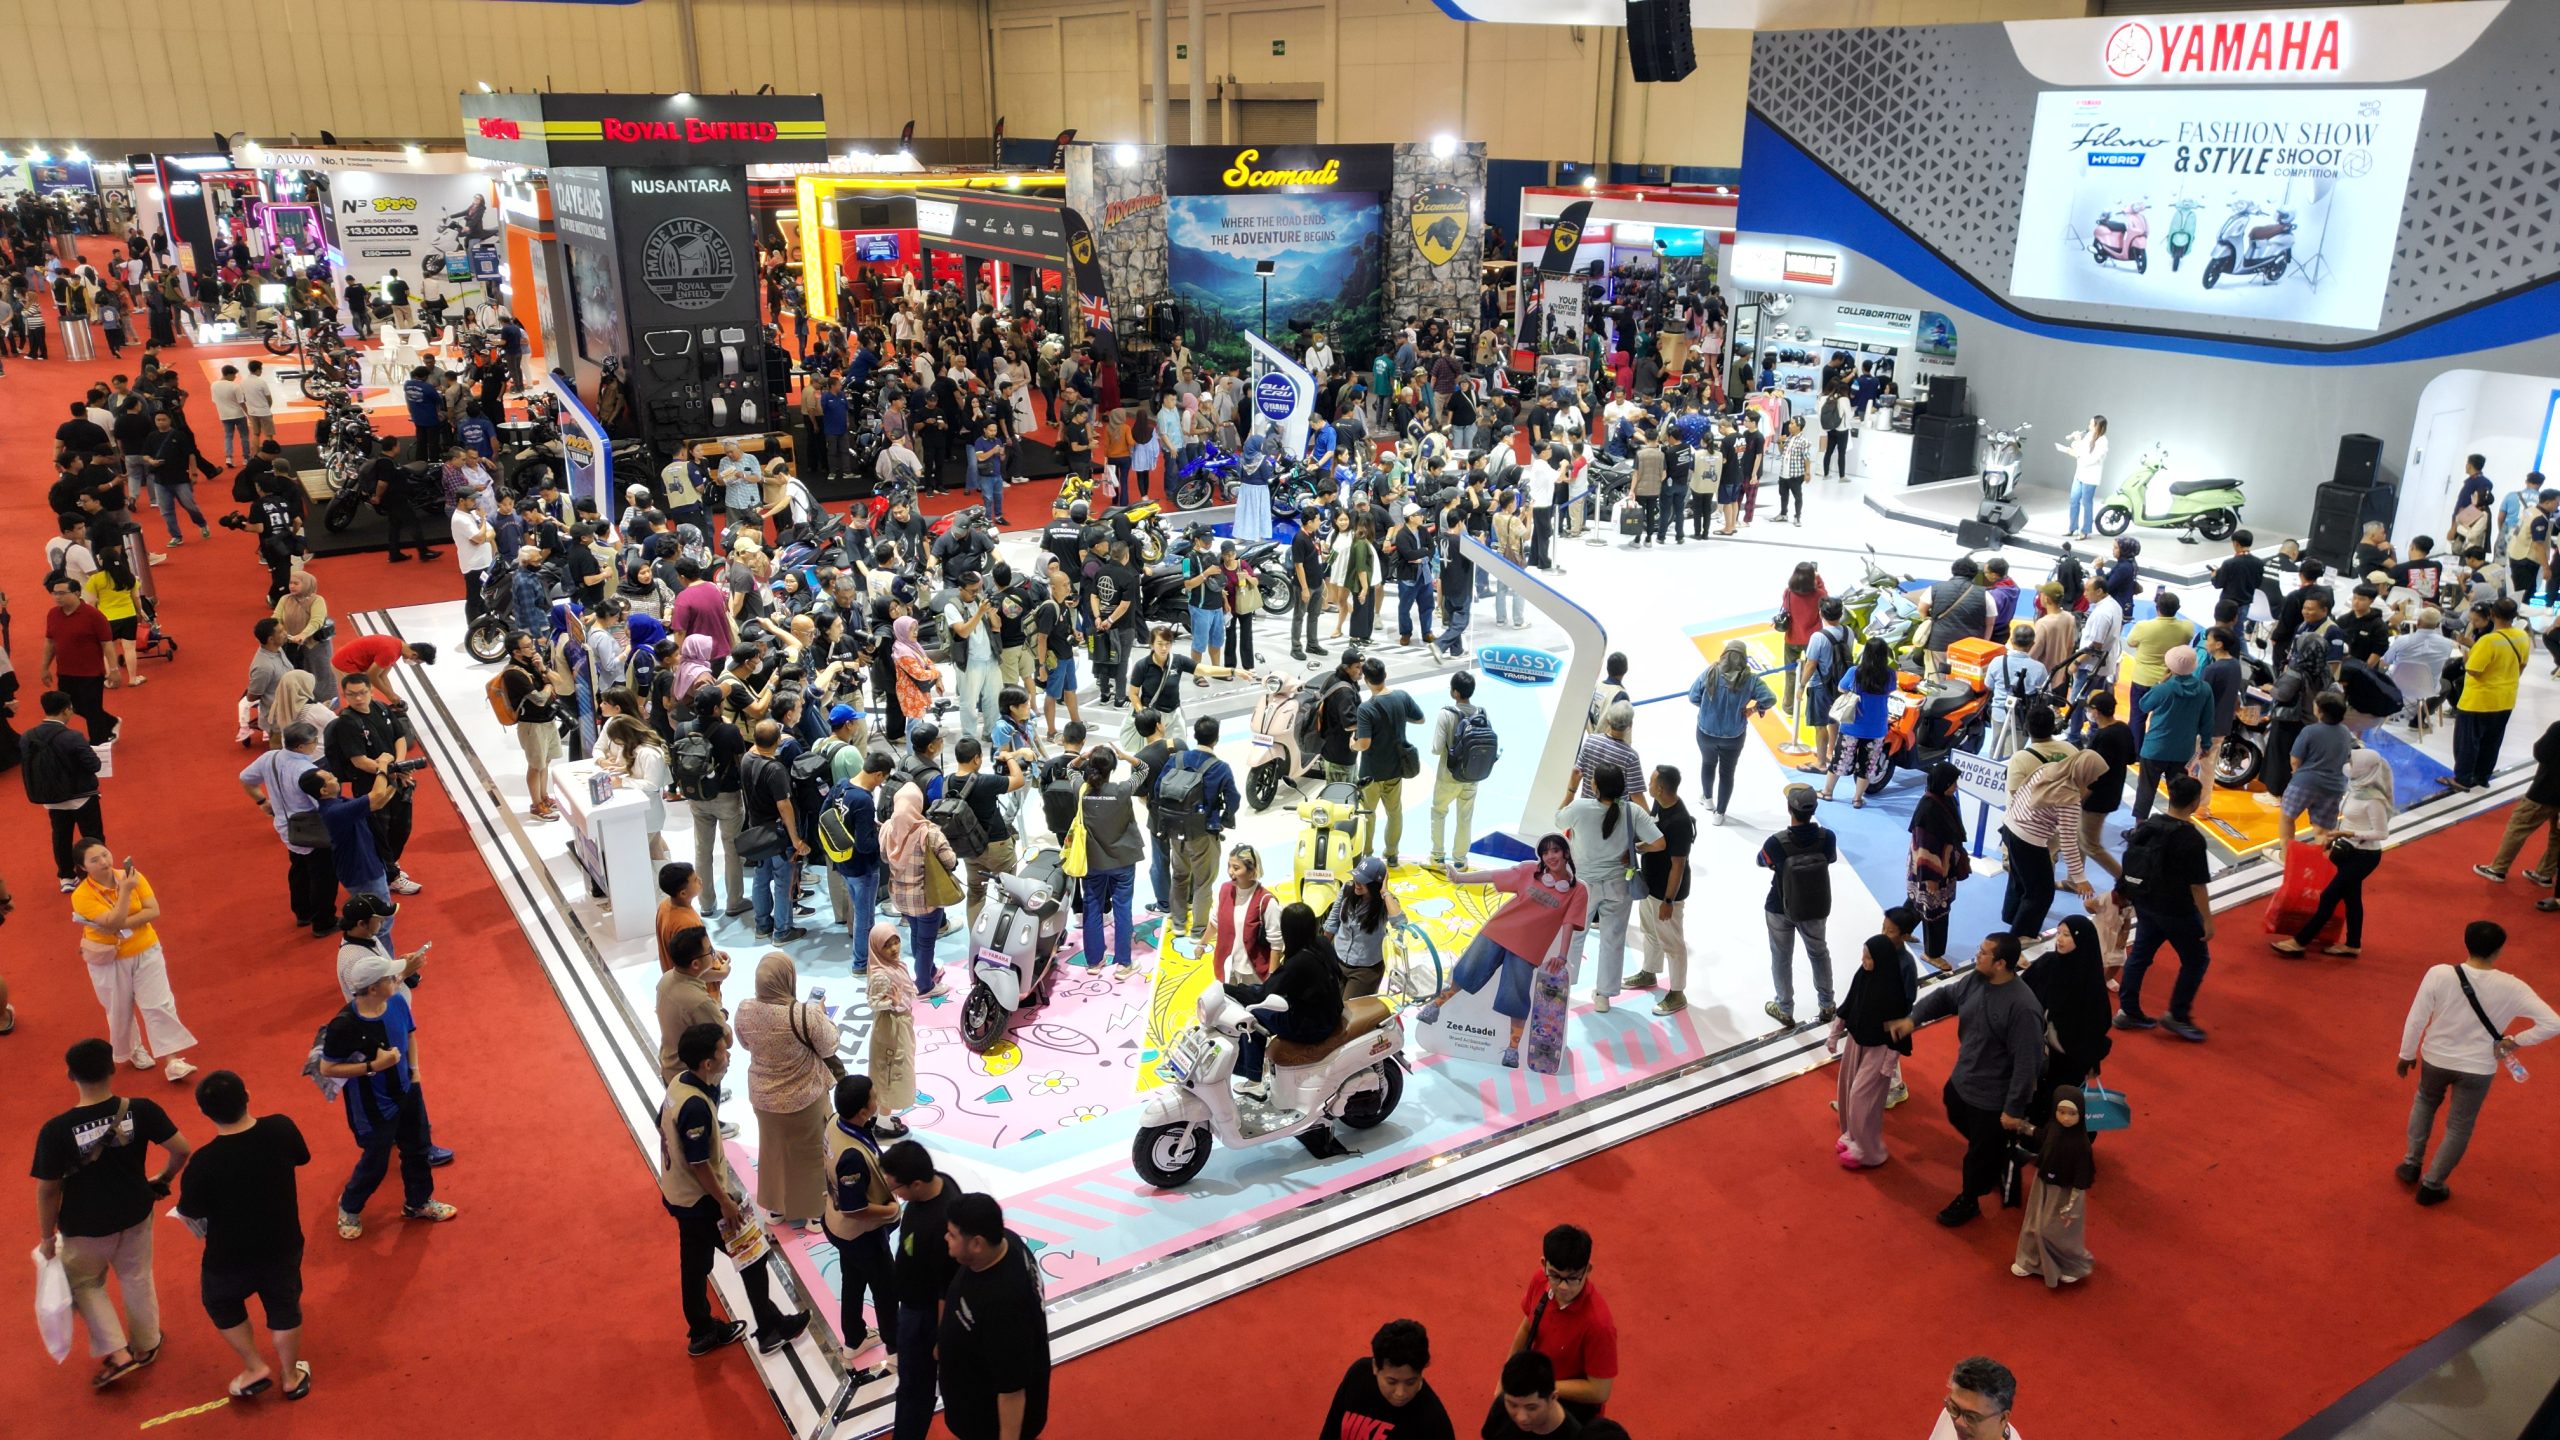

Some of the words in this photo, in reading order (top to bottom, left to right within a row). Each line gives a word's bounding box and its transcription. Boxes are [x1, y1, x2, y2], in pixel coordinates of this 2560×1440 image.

[2160, 20, 2340, 74] YAMAHA
[603, 118, 682, 143] ROYAL
[684, 117, 778, 144] ENFIELD
[2177, 121, 2289, 145] FASHION
[2297, 122, 2380, 147] SHOW
[276, 154, 314, 165] ALVA
[321, 156, 338, 166] No.
[339, 157, 344, 165] 1
[1222, 148, 1341, 188] Scomadi
[2092, 155, 2140, 165] HYBRID
[2174, 145, 2190, 173] &
[2194, 147, 2274, 175] STYLE
[2276, 148, 2343, 166] SHOOT
[2274, 167, 2339, 179] COMPETITION
[631, 178, 732, 194] NUSANTARA
[1102, 194, 1163, 235] ADVENTURE
[1221, 216, 1255, 229] WHERE
[1256, 216, 1275, 228] THE
[1276, 215, 1301, 227] ROAD
[1303, 214, 1327, 226] ENDS
[647, 230, 670, 272] MADE
[668, 220, 703, 236] LIKE
[711, 238, 732, 269] GUN
[1211, 234, 1230, 246] THE
[1232, 231, 1302, 246] ADVENTURE
[1303, 230, 1336, 243] BEGINS
[676, 281, 707, 291] ROYAL
[675, 290, 711, 300] ENFIELD
[1558, 295, 1578, 306] YOUR
[1837, 305, 1912, 322] COLLABORATION
[1887, 320, 1911, 329] PROJECT
[1259, 383, 1291, 391] BLU
[1260, 389, 1293, 397] CRU
[1268, 402, 1290, 412] YAMAHA
[1481, 649, 1560, 671] CLASSY
[1504, 672, 1536, 682] YAMAHA
[1954, 758, 1992, 777] RANGKA
[1975, 775, 2006, 793] DEBA
[1446, 1020, 1464, 1031] Zee
[1465, 1024, 1496, 1037] Asadel
[1340, 1410, 1396, 1440] NIKE
